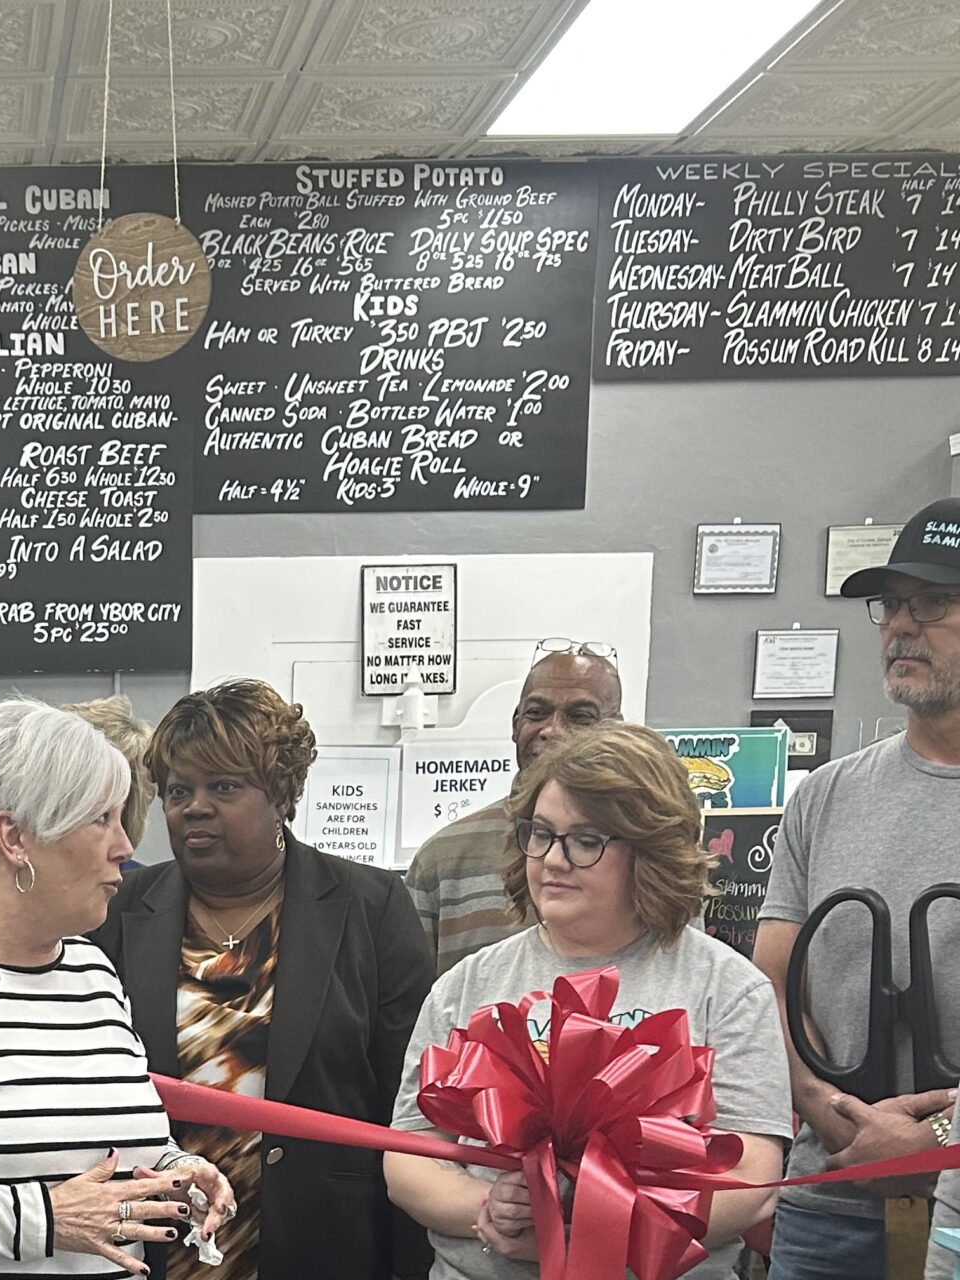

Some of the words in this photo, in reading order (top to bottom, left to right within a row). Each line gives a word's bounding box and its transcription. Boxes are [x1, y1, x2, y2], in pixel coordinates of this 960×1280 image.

[295, 165, 405, 194] STUFFED
[414, 164, 504, 191] POTATO
[656, 162, 784, 180] WEEKLY
[902, 179, 936, 192] HALF
[25, 185, 109, 213] CUBAN
[205, 194, 256, 212] MASHED
[259, 192, 304, 210] POTATO
[307, 193, 341, 210] BALL
[346, 189, 405, 210] STUFFED
[414, 191, 448, 206] WITH
[456, 188, 512, 208] GROUND
[516, 185, 557, 206] BEEF
[732, 181, 809, 217] PHILLY
[815, 182, 885, 218] STEAK
[29, 235, 80, 249] WHOLE
[199, 231, 270, 258] BLACK
[269, 231, 336, 258] BEANS
[343, 229, 395, 258] RICE
[409, 229, 474, 257] DAILY
[480, 229, 534, 253] SOUP
[537, 228, 589, 253] SPEC
[729, 218, 794, 253] DIRTY
[796, 217, 862, 254] BIRD
[90, 242, 195, 299] Order
[728, 253, 786, 289] MEAT
[784, 252, 845, 289] BALL
[241, 274, 301, 296] SERVED
[309, 273, 351, 294] WITH
[360, 274, 440, 293] BUTTERED
[447, 273, 504, 293] BREAD
[46, 295, 74, 313] MAY
[353, 293, 418, 322] KIDS
[725, 289, 828, 329] SLAMMIN
[828, 288, 915, 330] CHICKEN
[22, 315, 78, 331] WHOLE
[100, 298, 188, 338] HERE
[205, 321, 251, 349] HAM
[257, 327, 278, 344] OR
[291, 318, 353, 348] TURKEY
[428, 317, 489, 348] PBJ
[723, 328, 800, 366] POSSUM
[803, 327, 866, 366] ROAD
[867, 326, 910, 364] KILL
[15, 361, 113, 379] PEPPERONI
[359, 346, 444, 375] DRINKS
[16, 379, 72, 395] WHOLE
[205, 374, 266, 404] SWEET
[284, 372, 369, 403] UNSWEET
[378, 372, 409, 401] TEA
[423, 371, 515, 402] LEMONADE
[129, 395, 170, 410] MAYO
[20, 414, 104, 432] ORIGINAL
[205, 403, 275, 430] CANNED
[282, 402, 327, 428] SODA
[345, 400, 430, 429] BOTTLED
[438, 398, 497, 427] WATER
[204, 430, 304, 455] AUTHENTIC
[321, 427, 392, 455] CUBAN
[401, 425, 479, 455] BREAD
[499, 433, 524, 447] OR
[20, 442, 92, 468] ROAST
[98, 440, 167, 467] BEEF
[323, 453, 402, 481] HOAGIE
[410, 451, 466, 484] ROLL
[20, 488, 88, 508] CHEESE
[100, 487, 157, 508] TOAST
[6, 535, 59, 563] INTO
[69, 535, 85, 561] A
[90, 534, 163, 561] SALAD
[376, 575, 443, 591] NOTICE
[44, 602, 92, 622] FROM
[100, 602, 145, 621] YBOR
[147, 602, 181, 621] CITY
[370, 602, 385, 613] WE
[388, 601, 449, 613] GUARANTEE
[397, 619, 422, 630] FAST
[388, 637, 430, 648] SERVICE
[367, 656, 381, 667] NO
[428, 654, 451, 665] HOW
[370, 673, 397, 684] LONG
[415, 759, 511, 774] HOMEMADE
[332, 785, 363, 797] KIDS
[433, 778, 487, 793] JERKEY
[316, 802, 378, 811] SANDWICHES
[327, 815, 345, 823] ARE
[347, 815, 365, 823] FOR
[322, 827, 368, 835] CHILDREN
[358, 842, 376, 850] OLD
